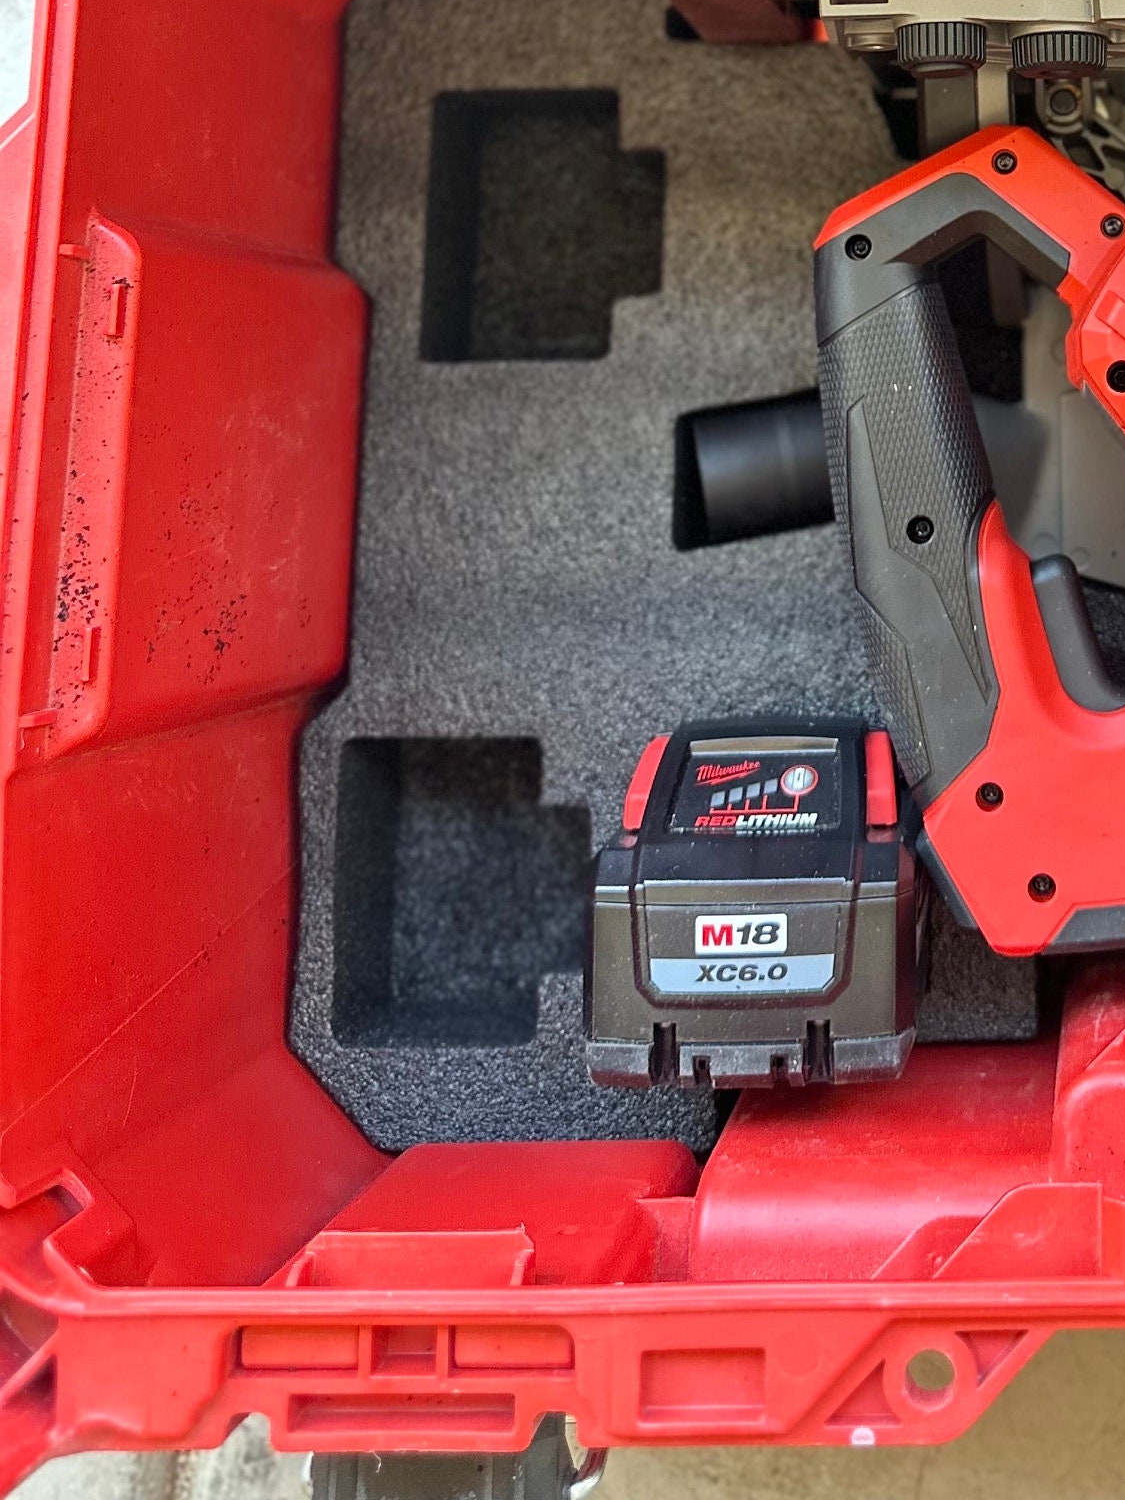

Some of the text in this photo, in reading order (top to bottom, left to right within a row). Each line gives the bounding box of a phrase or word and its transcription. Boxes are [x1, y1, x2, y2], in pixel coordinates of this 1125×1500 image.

[695, 760, 760, 785] Milwaukee
[694, 813, 818, 828] REDLITHIUM
[701, 922, 781, 946] M18
[696, 963, 788, 983] XC6.0
